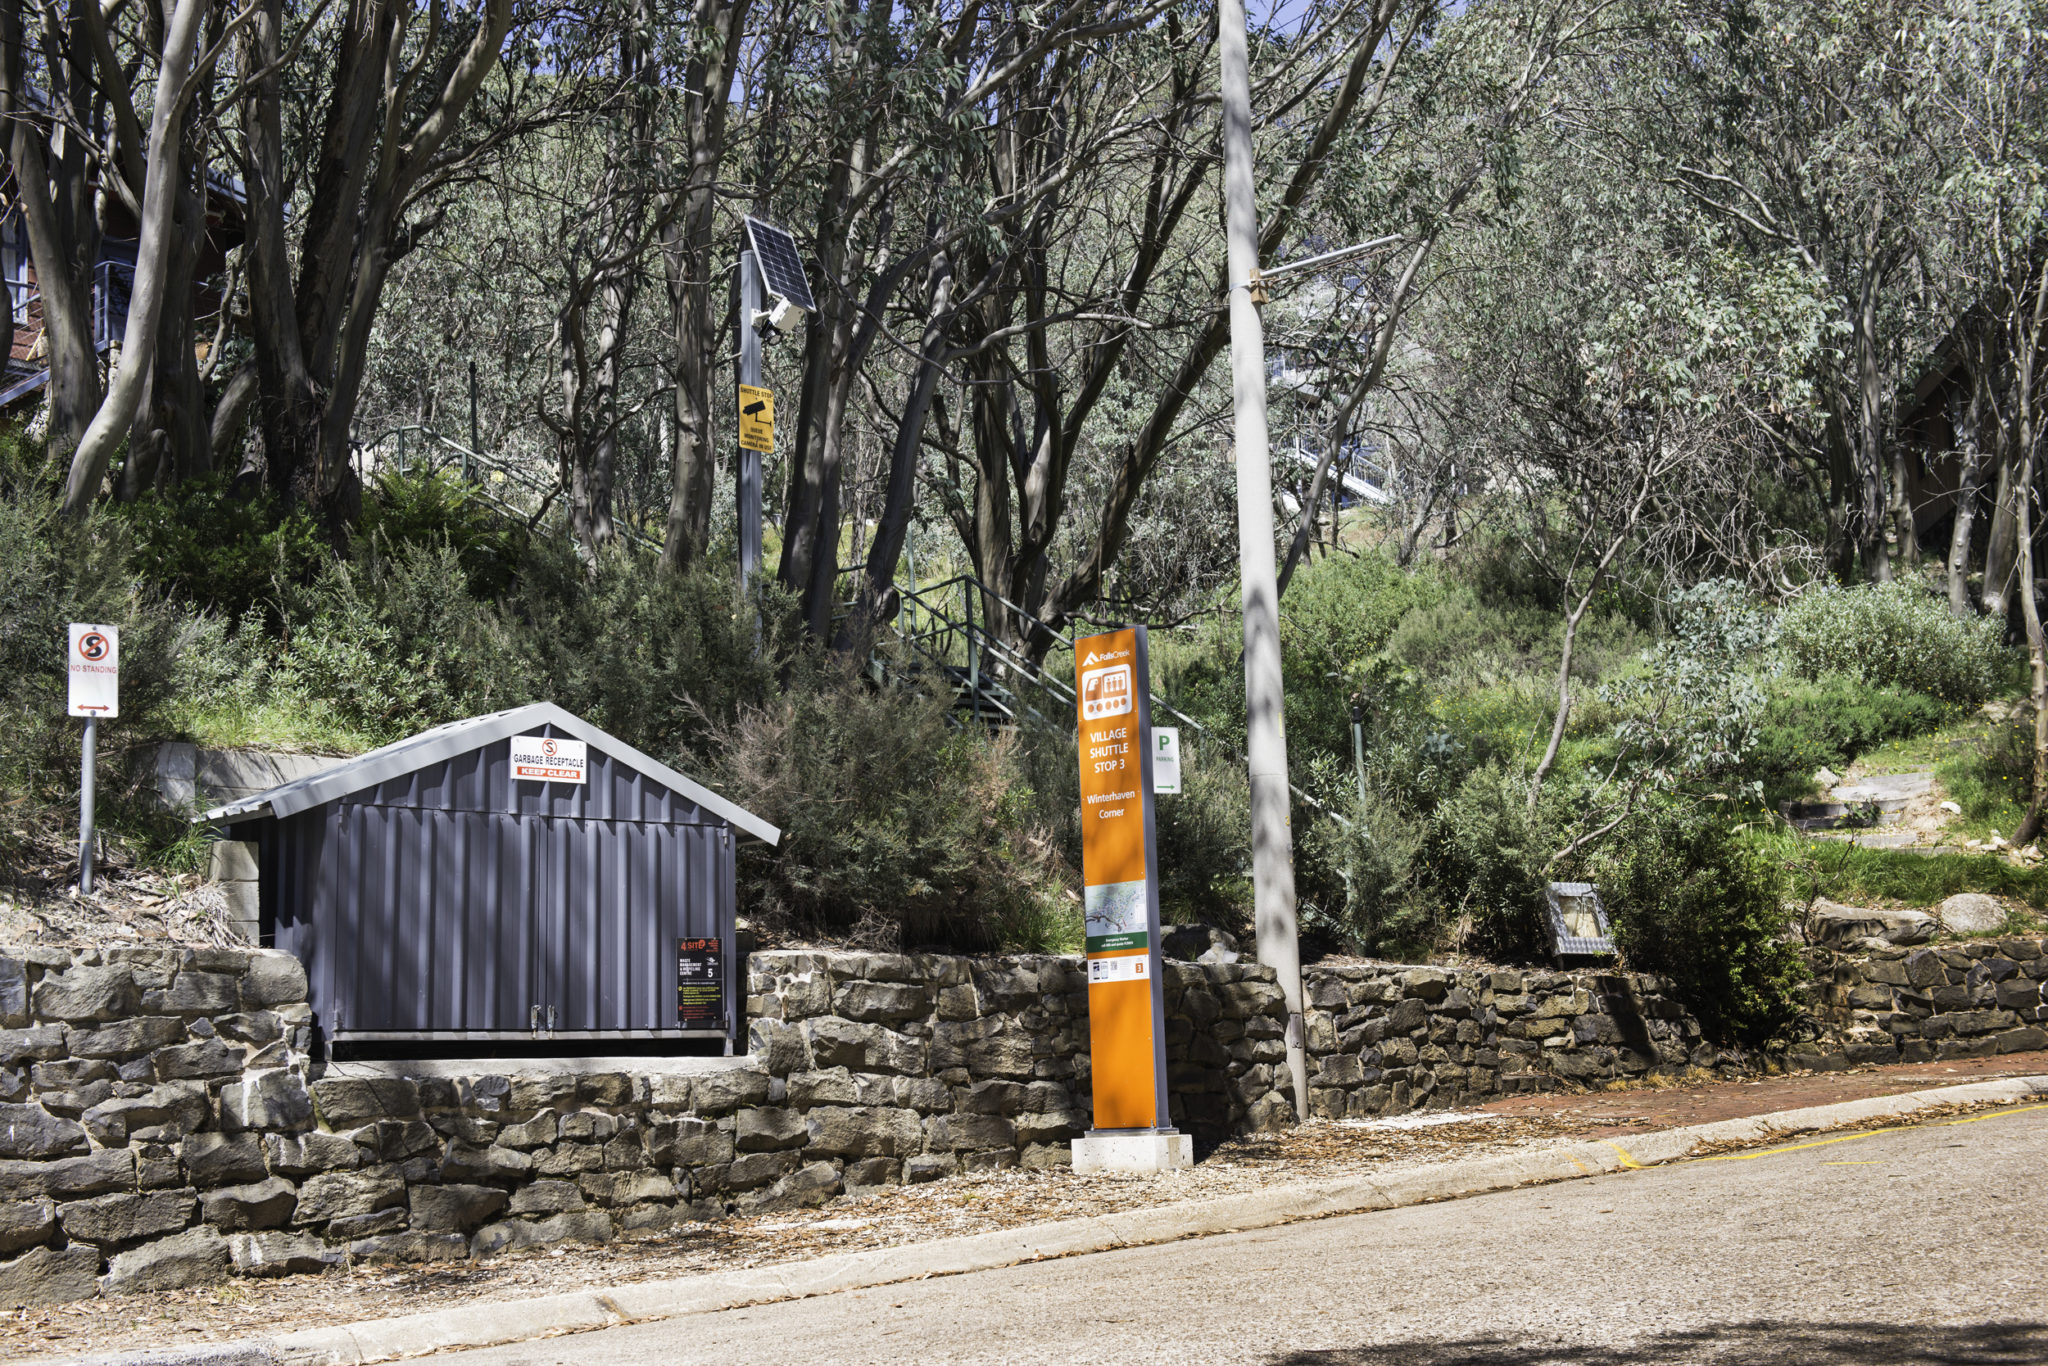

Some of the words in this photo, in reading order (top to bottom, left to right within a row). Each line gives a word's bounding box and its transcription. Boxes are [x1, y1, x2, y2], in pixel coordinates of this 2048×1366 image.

[740, 387, 760, 397] SHUTTLE
[761, 391, 773, 399] STOP
[82, 665, 117, 674] STANDING
[1090, 727, 1127, 743] VILLAGE
[1159, 735, 1170, 751] P
[1090, 743, 1129, 759] SHUTTLE
[514, 754, 544, 764] GARBAGE
[545, 756, 584, 768] RECEPTACLE
[1094, 760, 1118, 773] STOP
[1119, 759, 1125, 770] 3
[521, 767, 546, 776] KEEP
[547, 769, 577, 778] CLEAR
[1087, 790, 1136, 804] Winterhaven
[1099, 807, 1125, 819] Corner
[707, 968, 714, 978] 5
